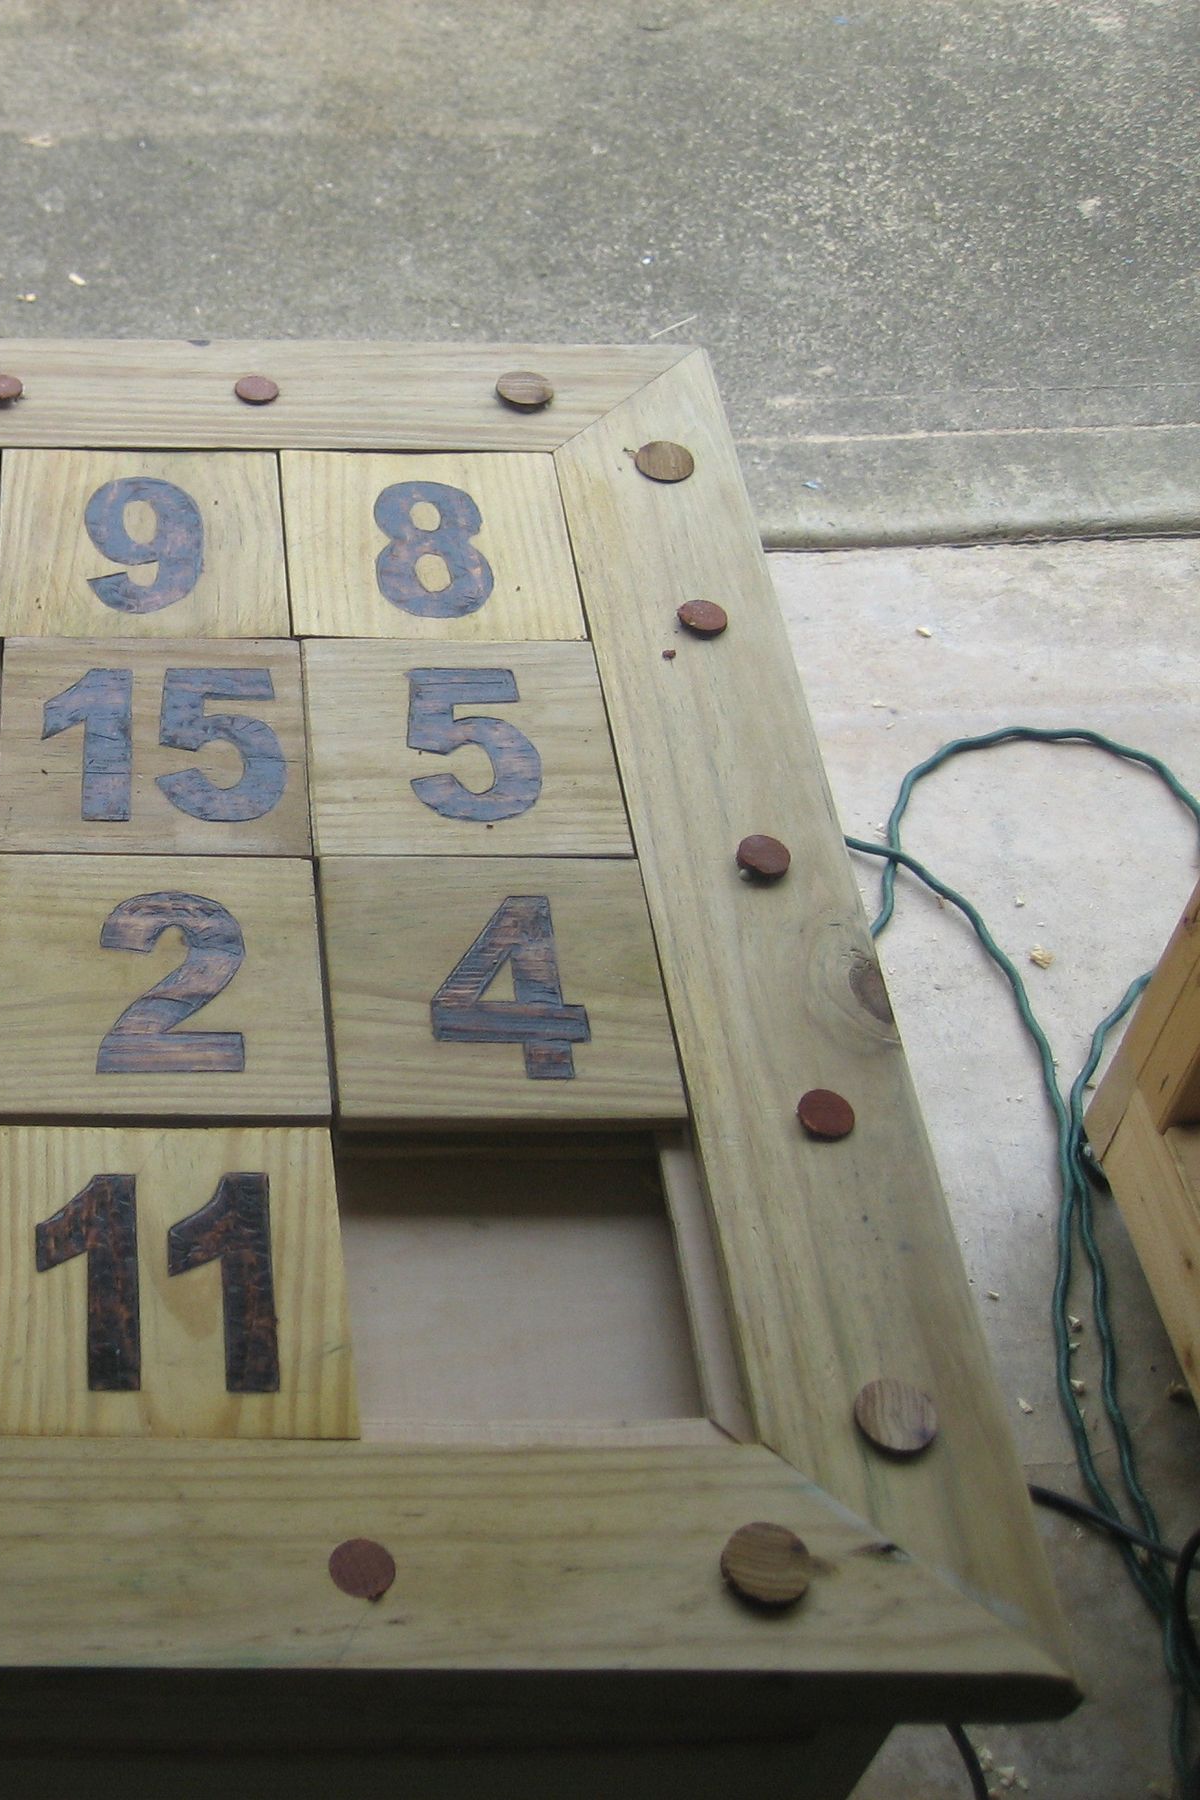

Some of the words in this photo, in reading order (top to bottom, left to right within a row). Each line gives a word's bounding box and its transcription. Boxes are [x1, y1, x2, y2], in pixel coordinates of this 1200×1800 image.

[85, 477, 204, 614] 9
[374, 480, 494, 618] 8
[41, 668, 287, 822] 15
[407, 667, 542, 822] 5
[96, 891, 245, 1074] 2
[430, 896, 591, 1079] 4
[35, 1172, 280, 1394] 11
